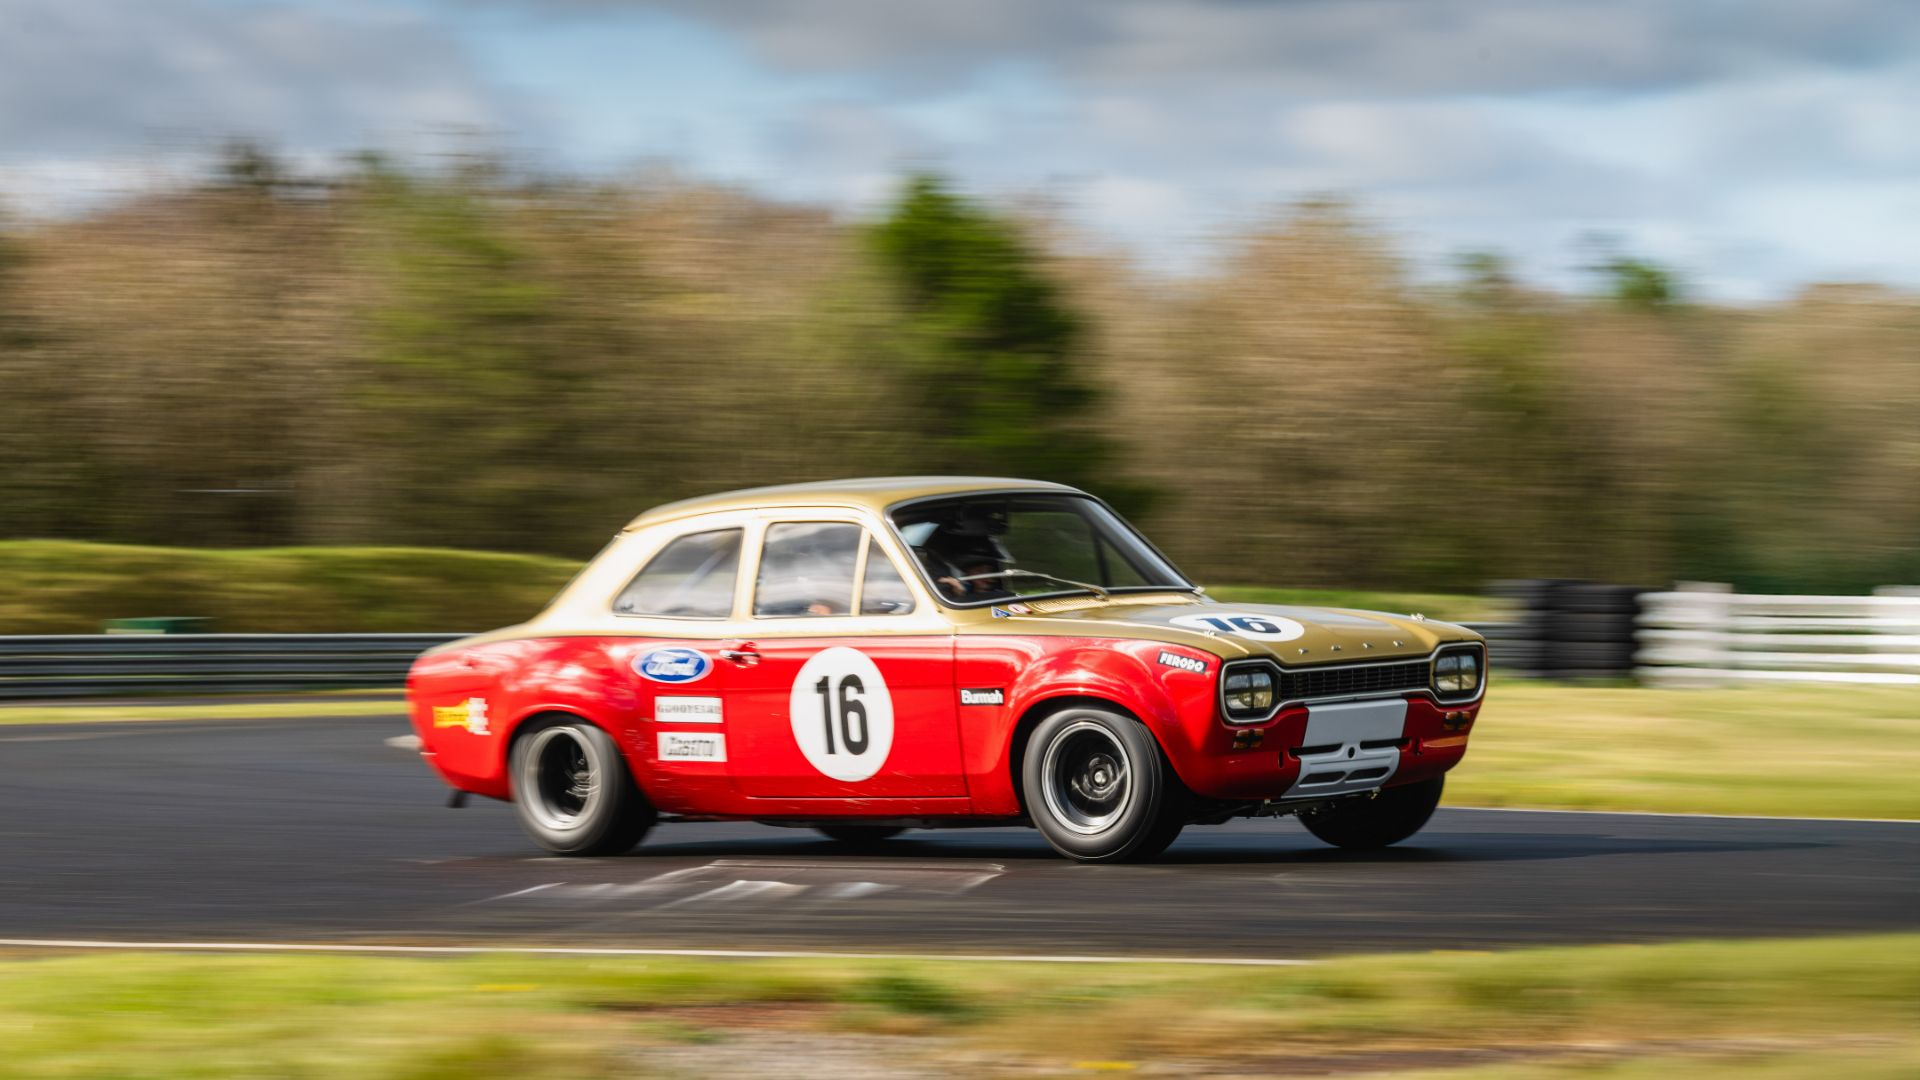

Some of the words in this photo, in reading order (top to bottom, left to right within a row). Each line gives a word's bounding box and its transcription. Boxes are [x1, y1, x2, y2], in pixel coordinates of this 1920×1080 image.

[1196, 616, 1282, 634] 16
[1159, 651, 1205, 672] FERODO
[960, 689, 1004, 704] Burmah
[815, 673, 869, 756] 16
